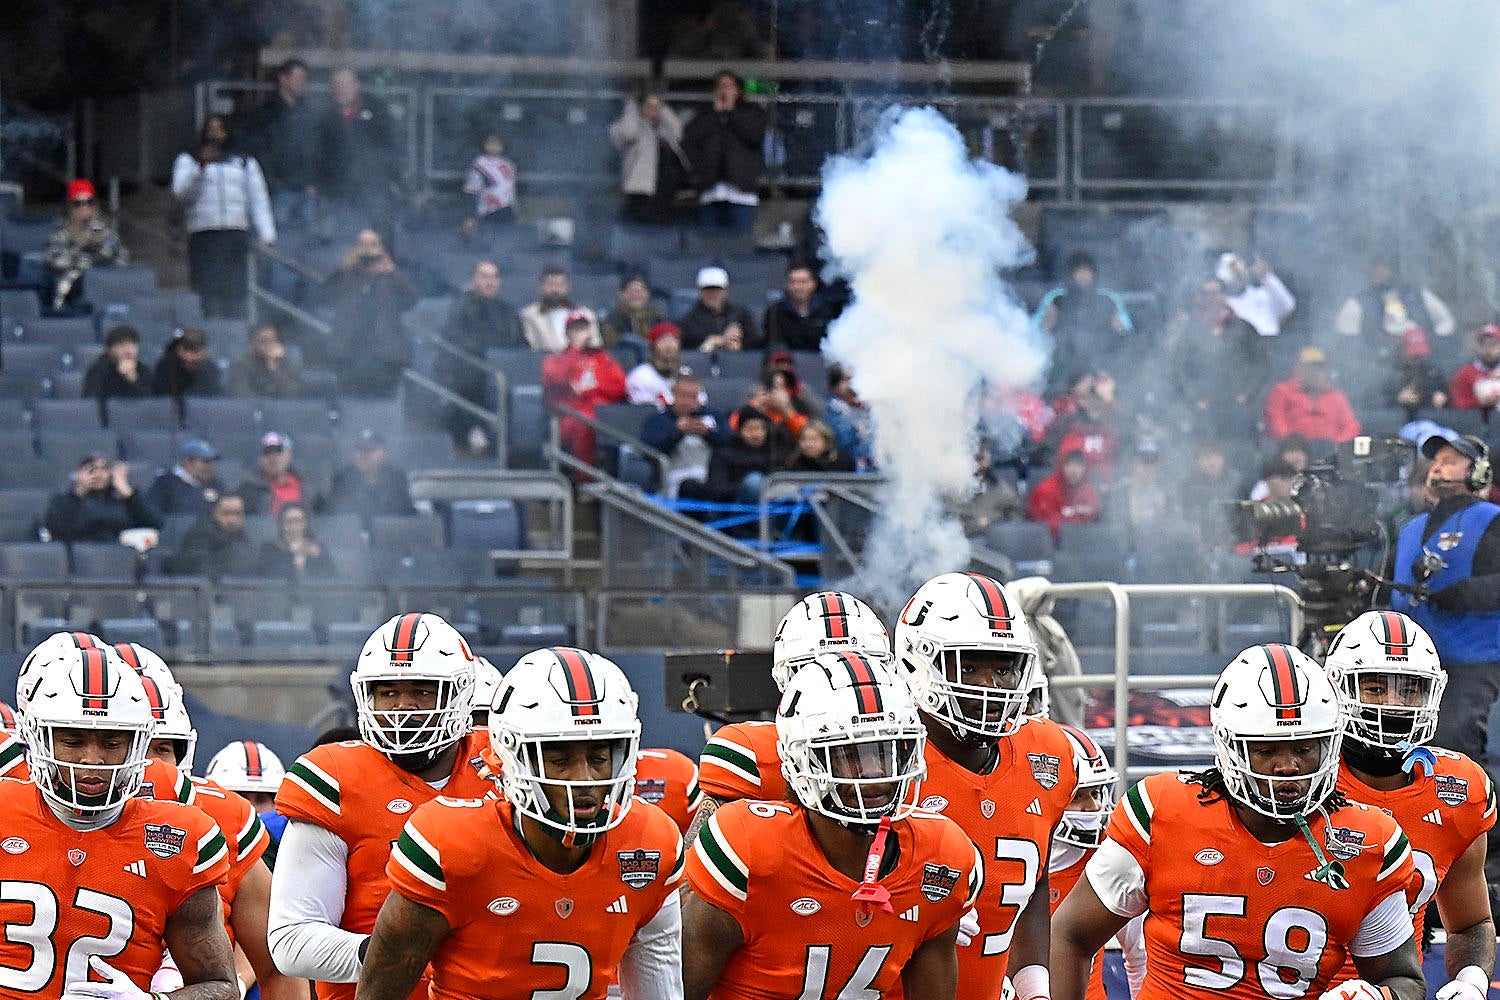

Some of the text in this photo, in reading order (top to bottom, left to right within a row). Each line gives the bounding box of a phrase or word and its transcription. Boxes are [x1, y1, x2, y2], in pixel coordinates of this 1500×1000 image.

[574, 718, 602, 726] miami
[1276, 719, 1302, 727] miami
[1200, 852, 1219, 861] ACC
[0, 880, 134, 996] 32
